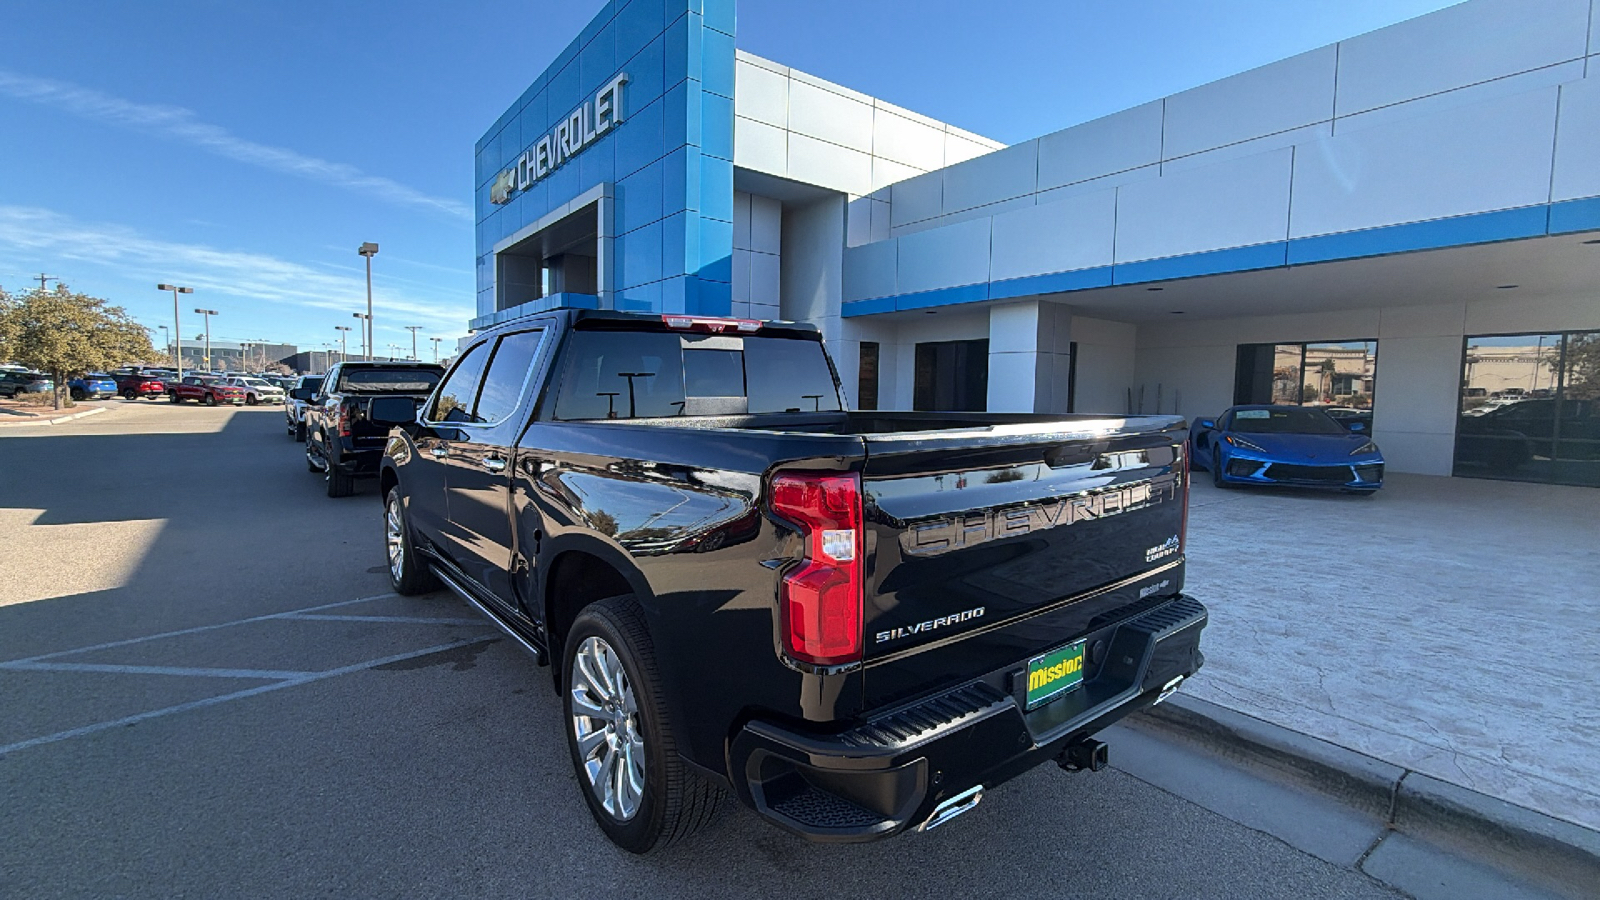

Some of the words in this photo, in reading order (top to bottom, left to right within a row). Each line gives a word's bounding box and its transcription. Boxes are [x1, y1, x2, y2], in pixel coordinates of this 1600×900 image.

[517, 72, 629, 192] CHEVROLET
[907, 473, 1177, 554] CHEVROLET
[876, 606, 985, 643] SILVERADO
